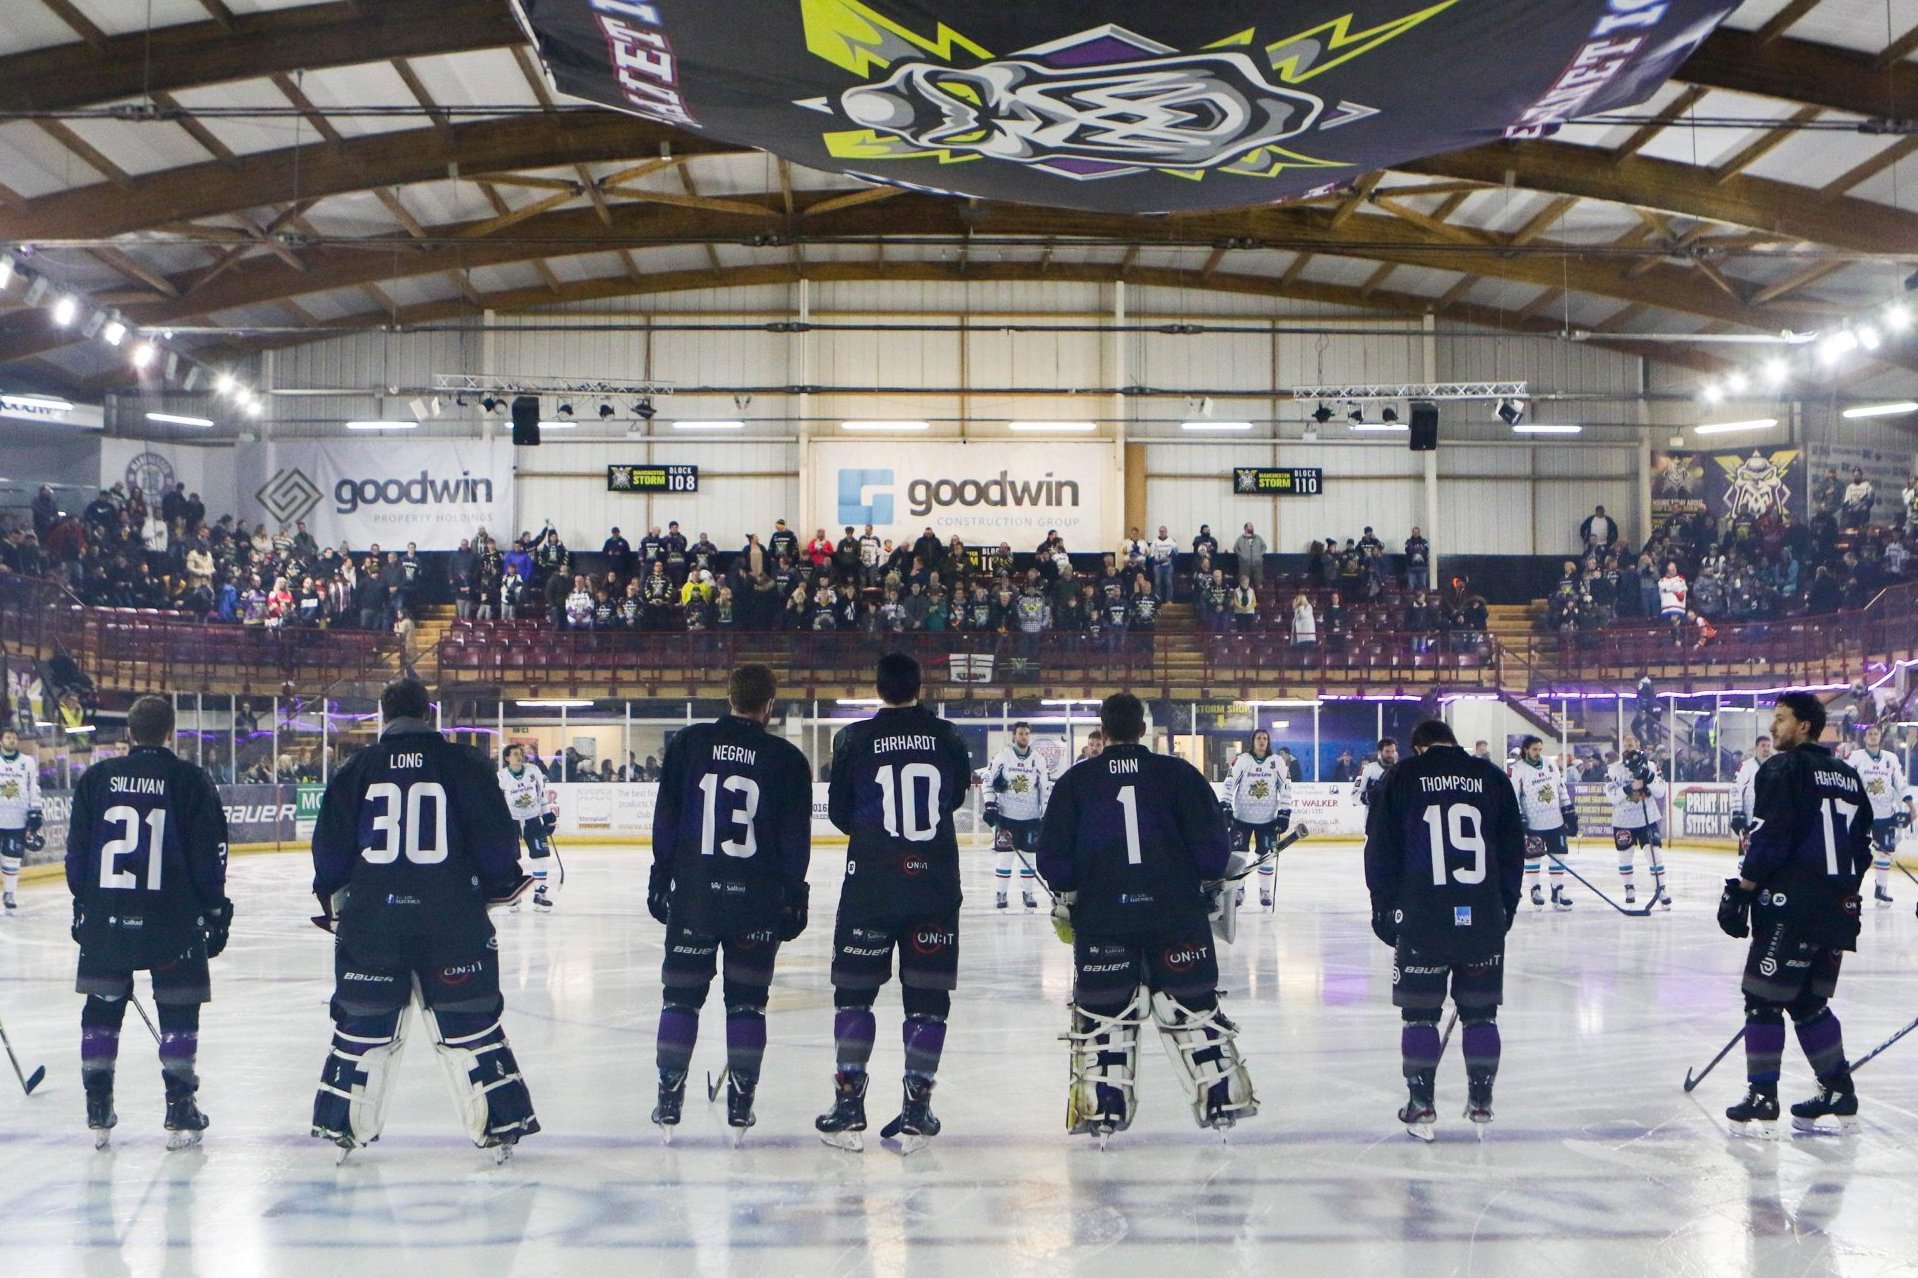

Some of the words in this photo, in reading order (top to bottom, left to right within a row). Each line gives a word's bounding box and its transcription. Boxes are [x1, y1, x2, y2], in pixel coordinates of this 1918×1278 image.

[633, 476, 665, 485] STORM
[668, 475, 695, 491] 108
[1258, 478, 1291, 488] STORM
[1294, 478, 1317, 493] 110
[334, 470, 493, 514] goodwin
[907, 470, 1079, 517] goodwin
[374, 514, 430, 523] PROPERTY
[435, 514, 493, 523] HOLDINGS
[936, 516, 1033, 527] CONSTRUCTION
[1038, 517, 1080, 527] GROUP
[874, 735, 937, 754] EHRHARDT
[390, 753, 423, 769] LONG
[713, 744, 756, 766] NEGRIN
[1109, 758, 1139, 774] GINN
[110, 776, 165, 795] SULLIVAN
[1419, 776, 1483, 793] THOMPSON
[874, 762, 942, 842] 10
[1686, 792, 1717, 813] PRINT
[361, 781, 448, 864] 30
[698, 773, 760, 858] 13
[1116, 785, 1142, 865] 1
[1686, 814, 1718, 834] STITCH
[100, 805, 166, 890] 21
[1423, 803, 1486, 886] 19
[673, 945, 713, 955] BAUE
[1083, 961, 1130, 972] BAUER
[343, 972, 394, 983] BAUER
